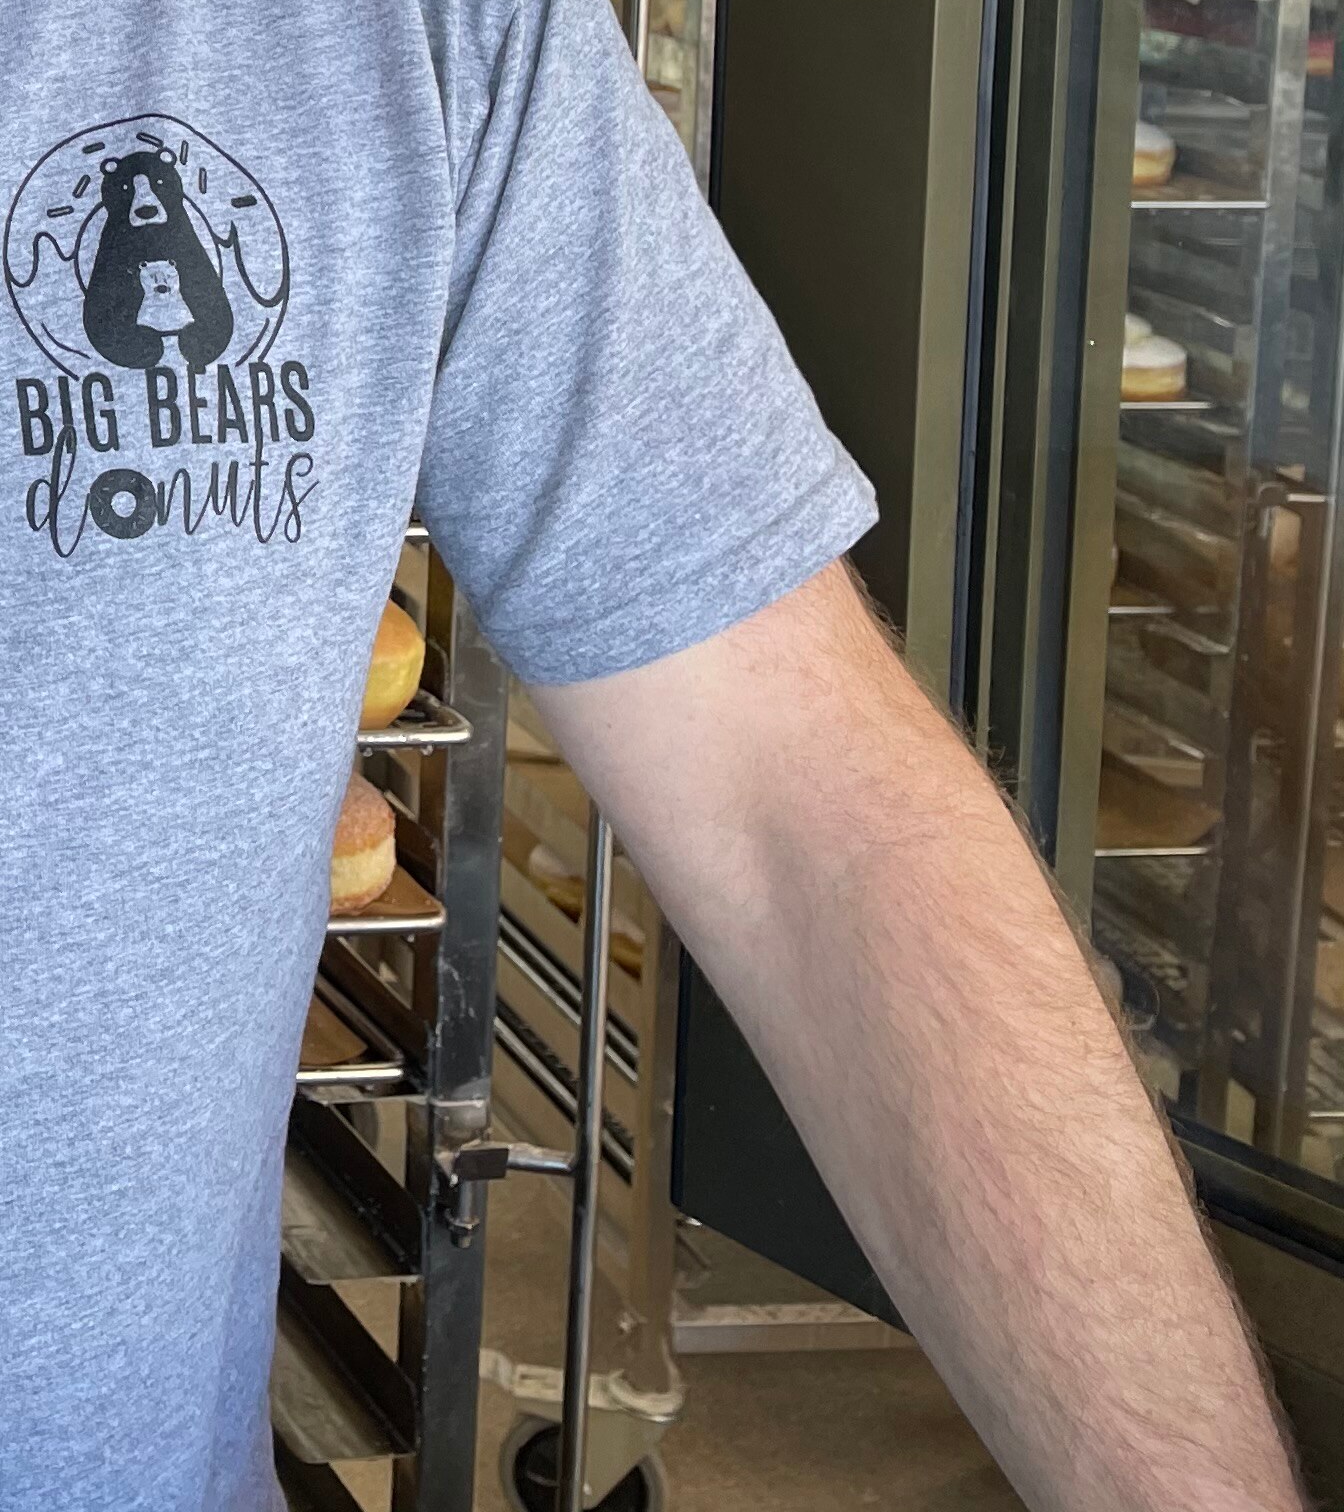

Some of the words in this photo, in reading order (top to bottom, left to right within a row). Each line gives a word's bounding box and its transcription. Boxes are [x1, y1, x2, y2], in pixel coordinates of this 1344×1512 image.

[16, 372, 119, 455] BIG
[145, 361, 315, 448] BEARS
[26, 424, 319, 558] donuts
